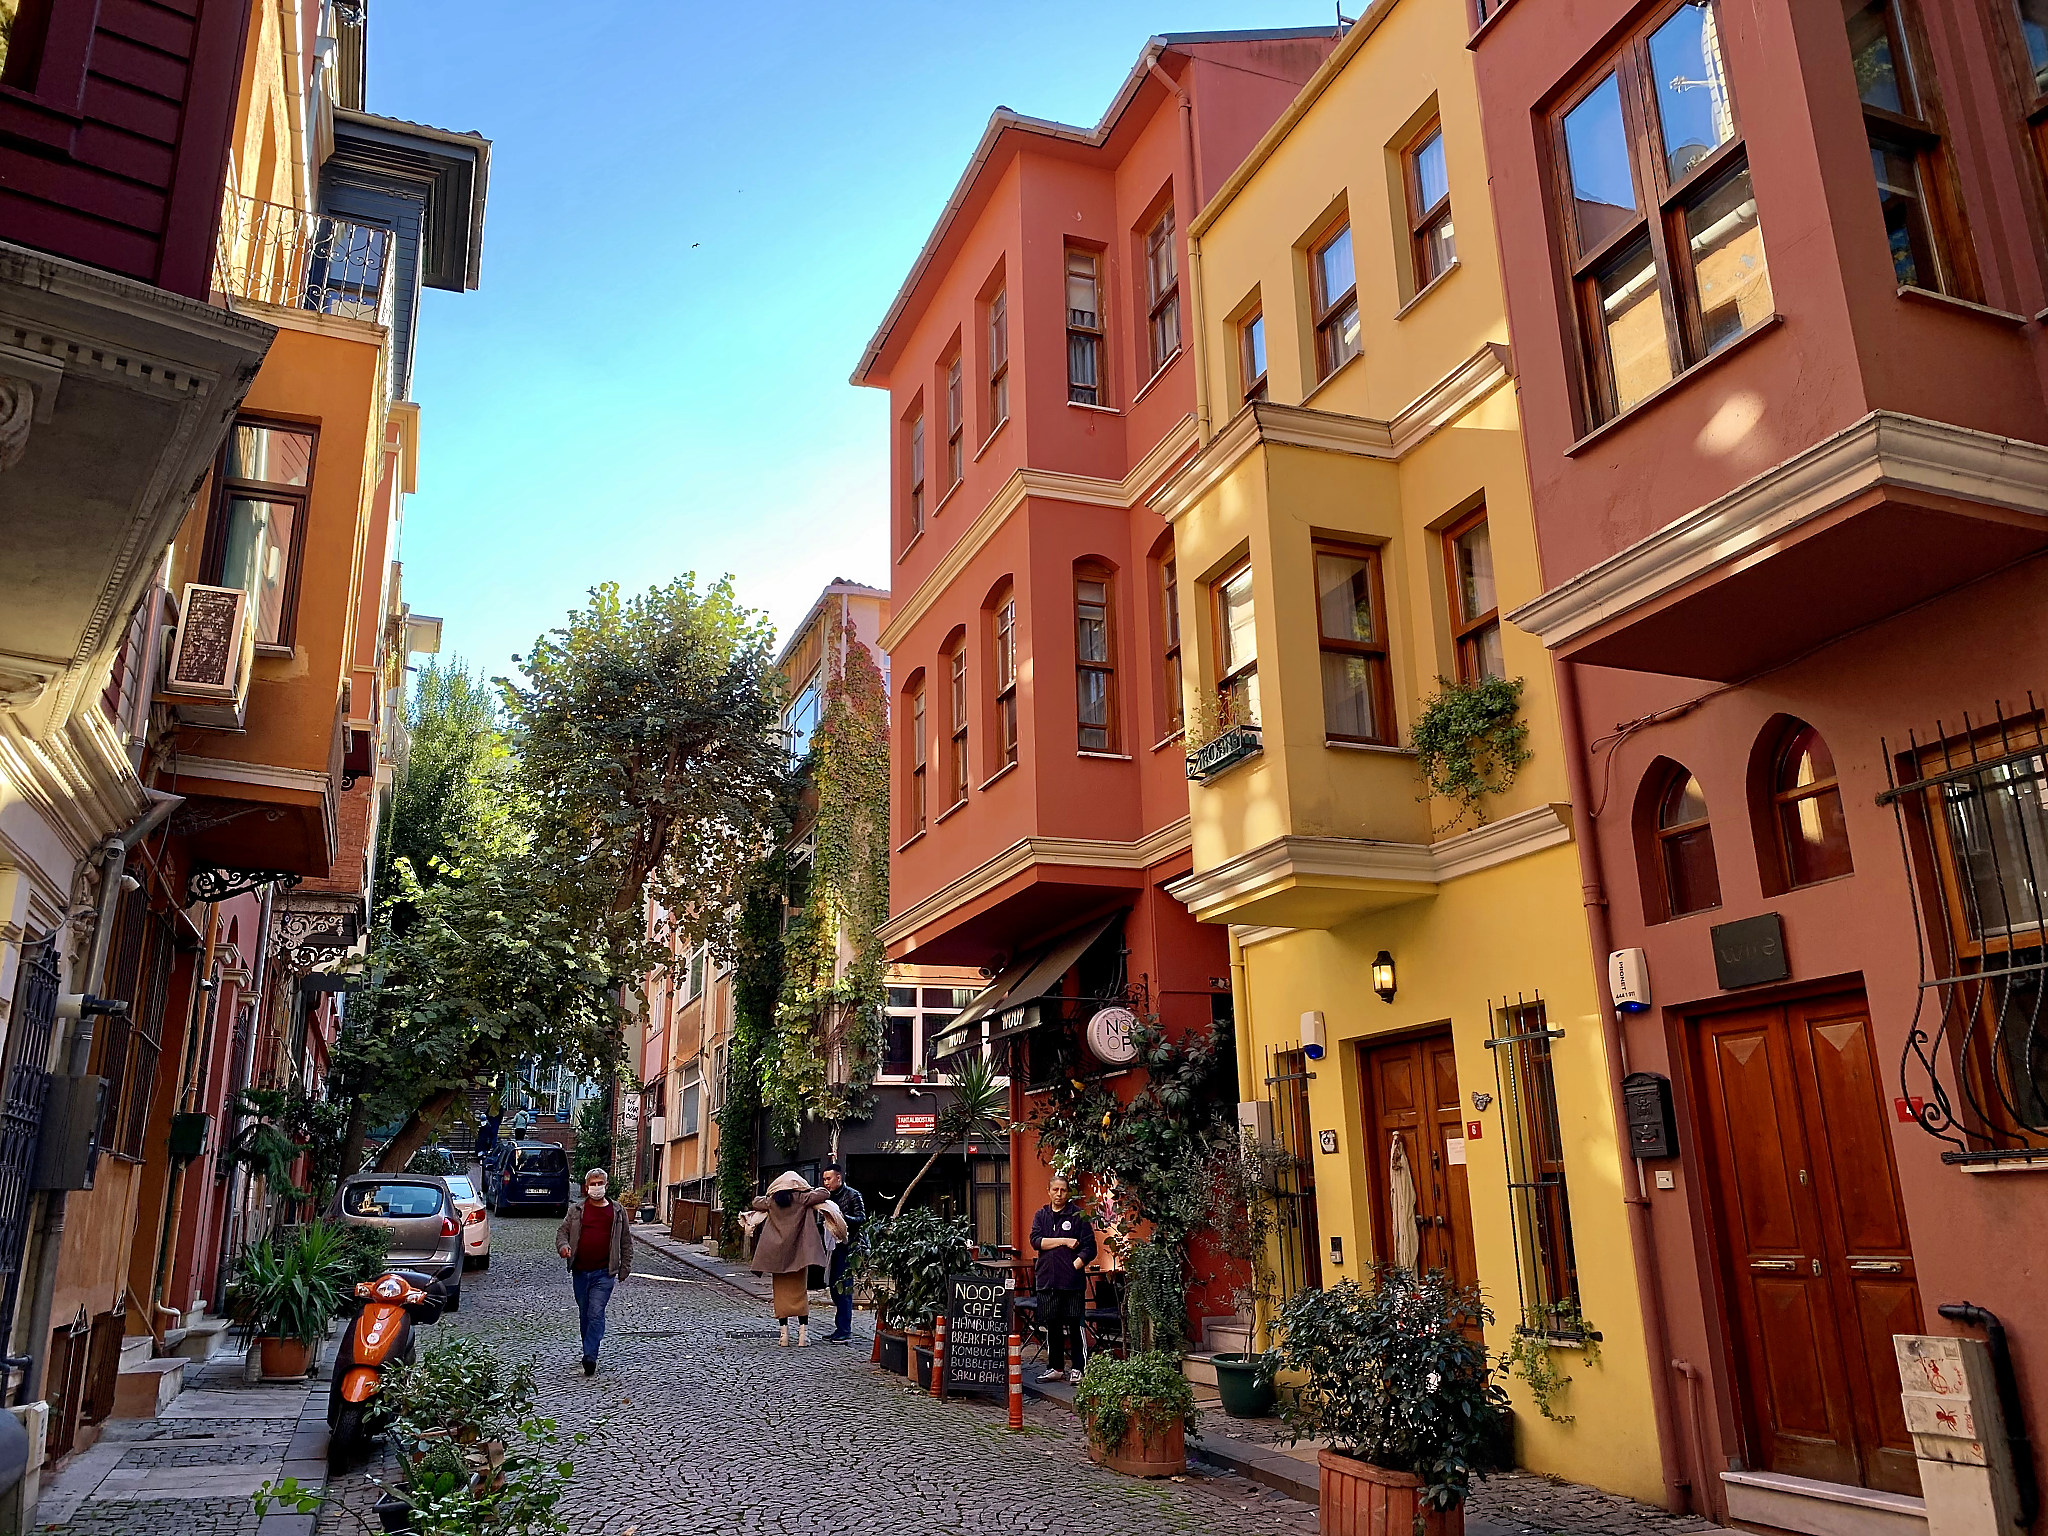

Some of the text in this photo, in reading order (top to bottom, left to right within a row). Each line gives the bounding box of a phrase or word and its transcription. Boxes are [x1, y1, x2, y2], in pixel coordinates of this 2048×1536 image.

[1471, 1125, 1477, 1135] 6
[955, 1282, 1006, 1303] NOOP
[963, 1303, 1003, 1318] CAFE
[951, 1316, 1008, 1332] HAMBURGER
[951, 1330, 1008, 1346] BREAKFAST
[951, 1345, 1006, 1358] KOMBUCHA
